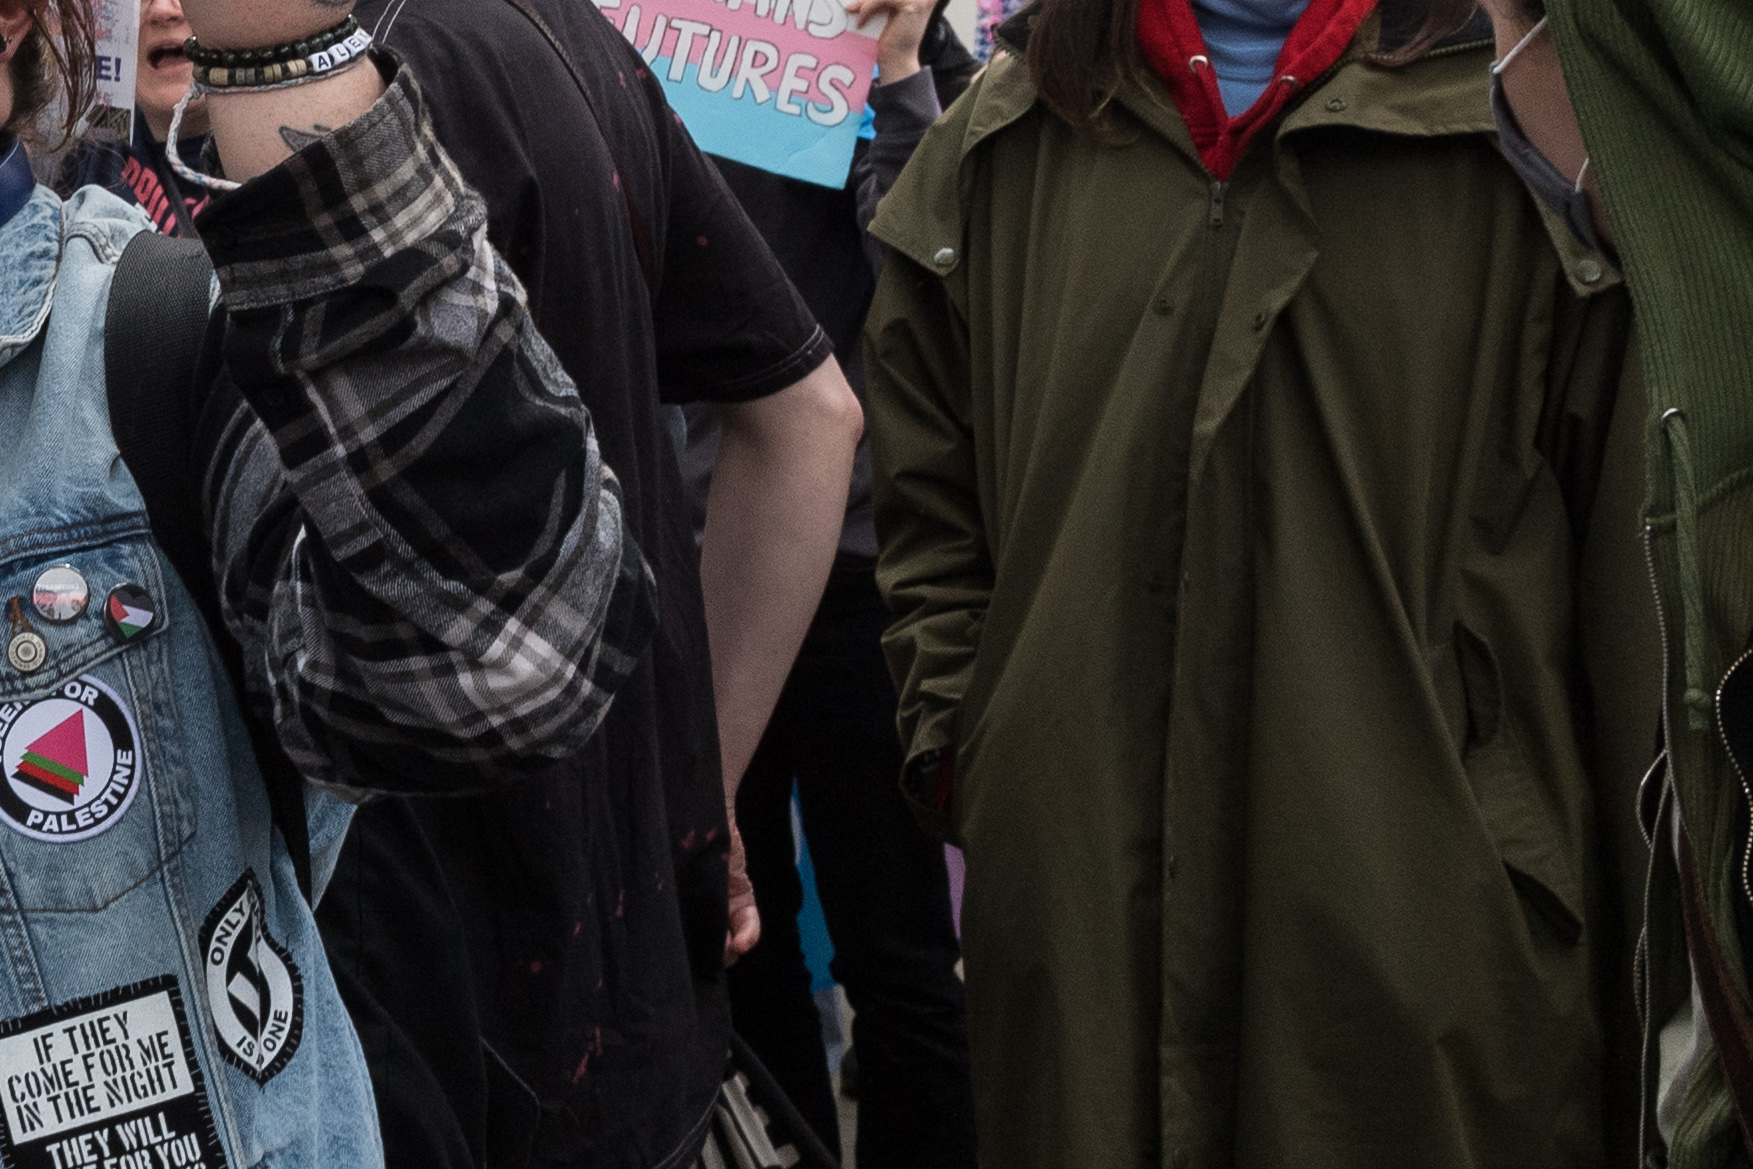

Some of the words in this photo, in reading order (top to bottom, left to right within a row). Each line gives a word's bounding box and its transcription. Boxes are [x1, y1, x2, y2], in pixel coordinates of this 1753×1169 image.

[56, 681, 99, 707] OR
[25, 748, 134, 833] PALESTINE
[209, 900, 246, 967] ONLY
[6, 1058, 80, 1105] COME
[81, 1043, 136, 1083] FOR
[136, 1030, 175, 1067] ME
[33, 1032, 54, 1066] IF
[62, 1010, 131, 1056] THEY
[15, 1101, 44, 1135] IN
[46, 1084, 102, 1124] THE
[102, 1060, 179, 1109] NIGHT
[45, 1127, 111, 1169] THEY
[115, 1111, 177, 1152] WILL
[154, 1132, 203, 1169] YOU
